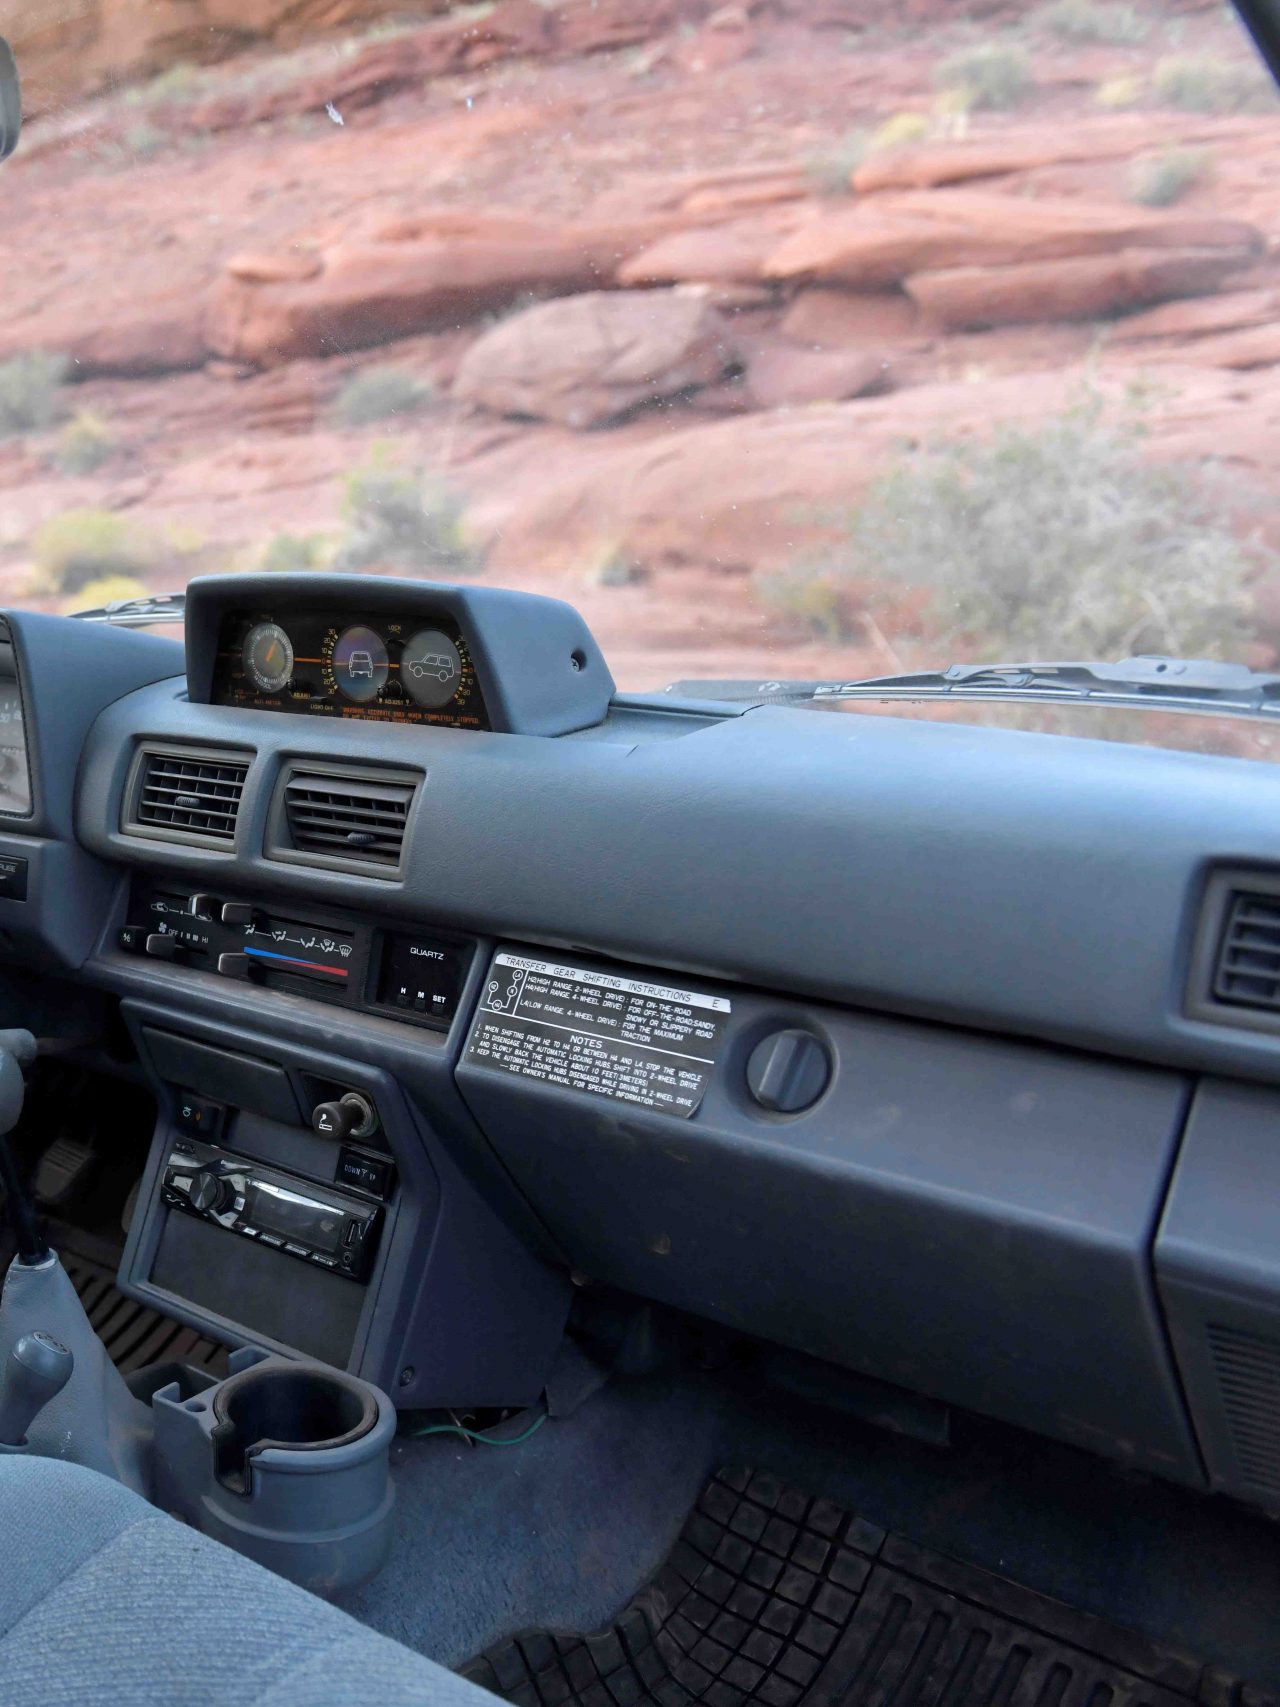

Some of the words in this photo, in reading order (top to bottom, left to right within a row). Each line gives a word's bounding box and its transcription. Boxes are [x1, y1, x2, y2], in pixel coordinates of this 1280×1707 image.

[410, 947, 444, 960] QUARTZ
[506, 957, 546, 971] TRANSFER
[553, 967, 576, 978] GEAR
[583, 973, 621, 988] SHIFTING
[628, 982, 691, 1003] INSTRUCTIONS
[712, 999, 720, 1007] E
[432, 994, 446, 1004] SET
[572, 994, 600, 1005] 4-WHEEL
[575, 986, 603, 997] 2-WHEEL
[646, 1000, 692, 1016] ON-THE-ROAD
[567, 1010, 595, 1021] 4-WHEEL
[654, 1029, 684, 1040] MAXIMUM
[620, 1030, 651, 1042] TRACTION
[625, 1014, 646, 1023] SNOWY
[661, 1022, 693, 1034] SLIPPERY
[695, 1029, 713, 1038] ROAD
[485, 1025, 499, 1033] WHEN
[501, 1029, 525, 1039] SHIFTING
[583, 1048, 608, 1058] BETWEEN
[646, 1063, 660, 1071] STOP
[678, 1071, 702, 1081] VEHICLE
[570, 1035, 603, 1048] NOTES
[491, 1035, 521, 1046] DISENGAGE
[536, 1045, 567, 1057] AUTOMATIC
[569, 1053, 593, 1064] LOCKING
[613, 1064, 630, 1073] SHIFT
[633, 1069, 647, 1077] INTO
[649, 1073, 678, 1084] 2-WHEEL
[680, 1080, 698, 1089] DRIVE
[492, 1043, 512, 1053] SLOWLY
[545, 1056, 568, 1066] VEHICLE
[571, 1063, 589, 1071] ABOUT
[503, 1054, 529, 1065] AUTOMATIC
[531, 1061, 552, 1070] LOCKING
[568, 1071, 600, 1083] DISENGAGED
[601, 1079, 618, 1087] WHILE
[619, 1083, 639, 1092] DRIVING
[676, 1097, 693, 1106] DRIVE
[548, 1074, 571, 1084] MANUAL
[587, 1084, 613, 1094] SPECIFIC
